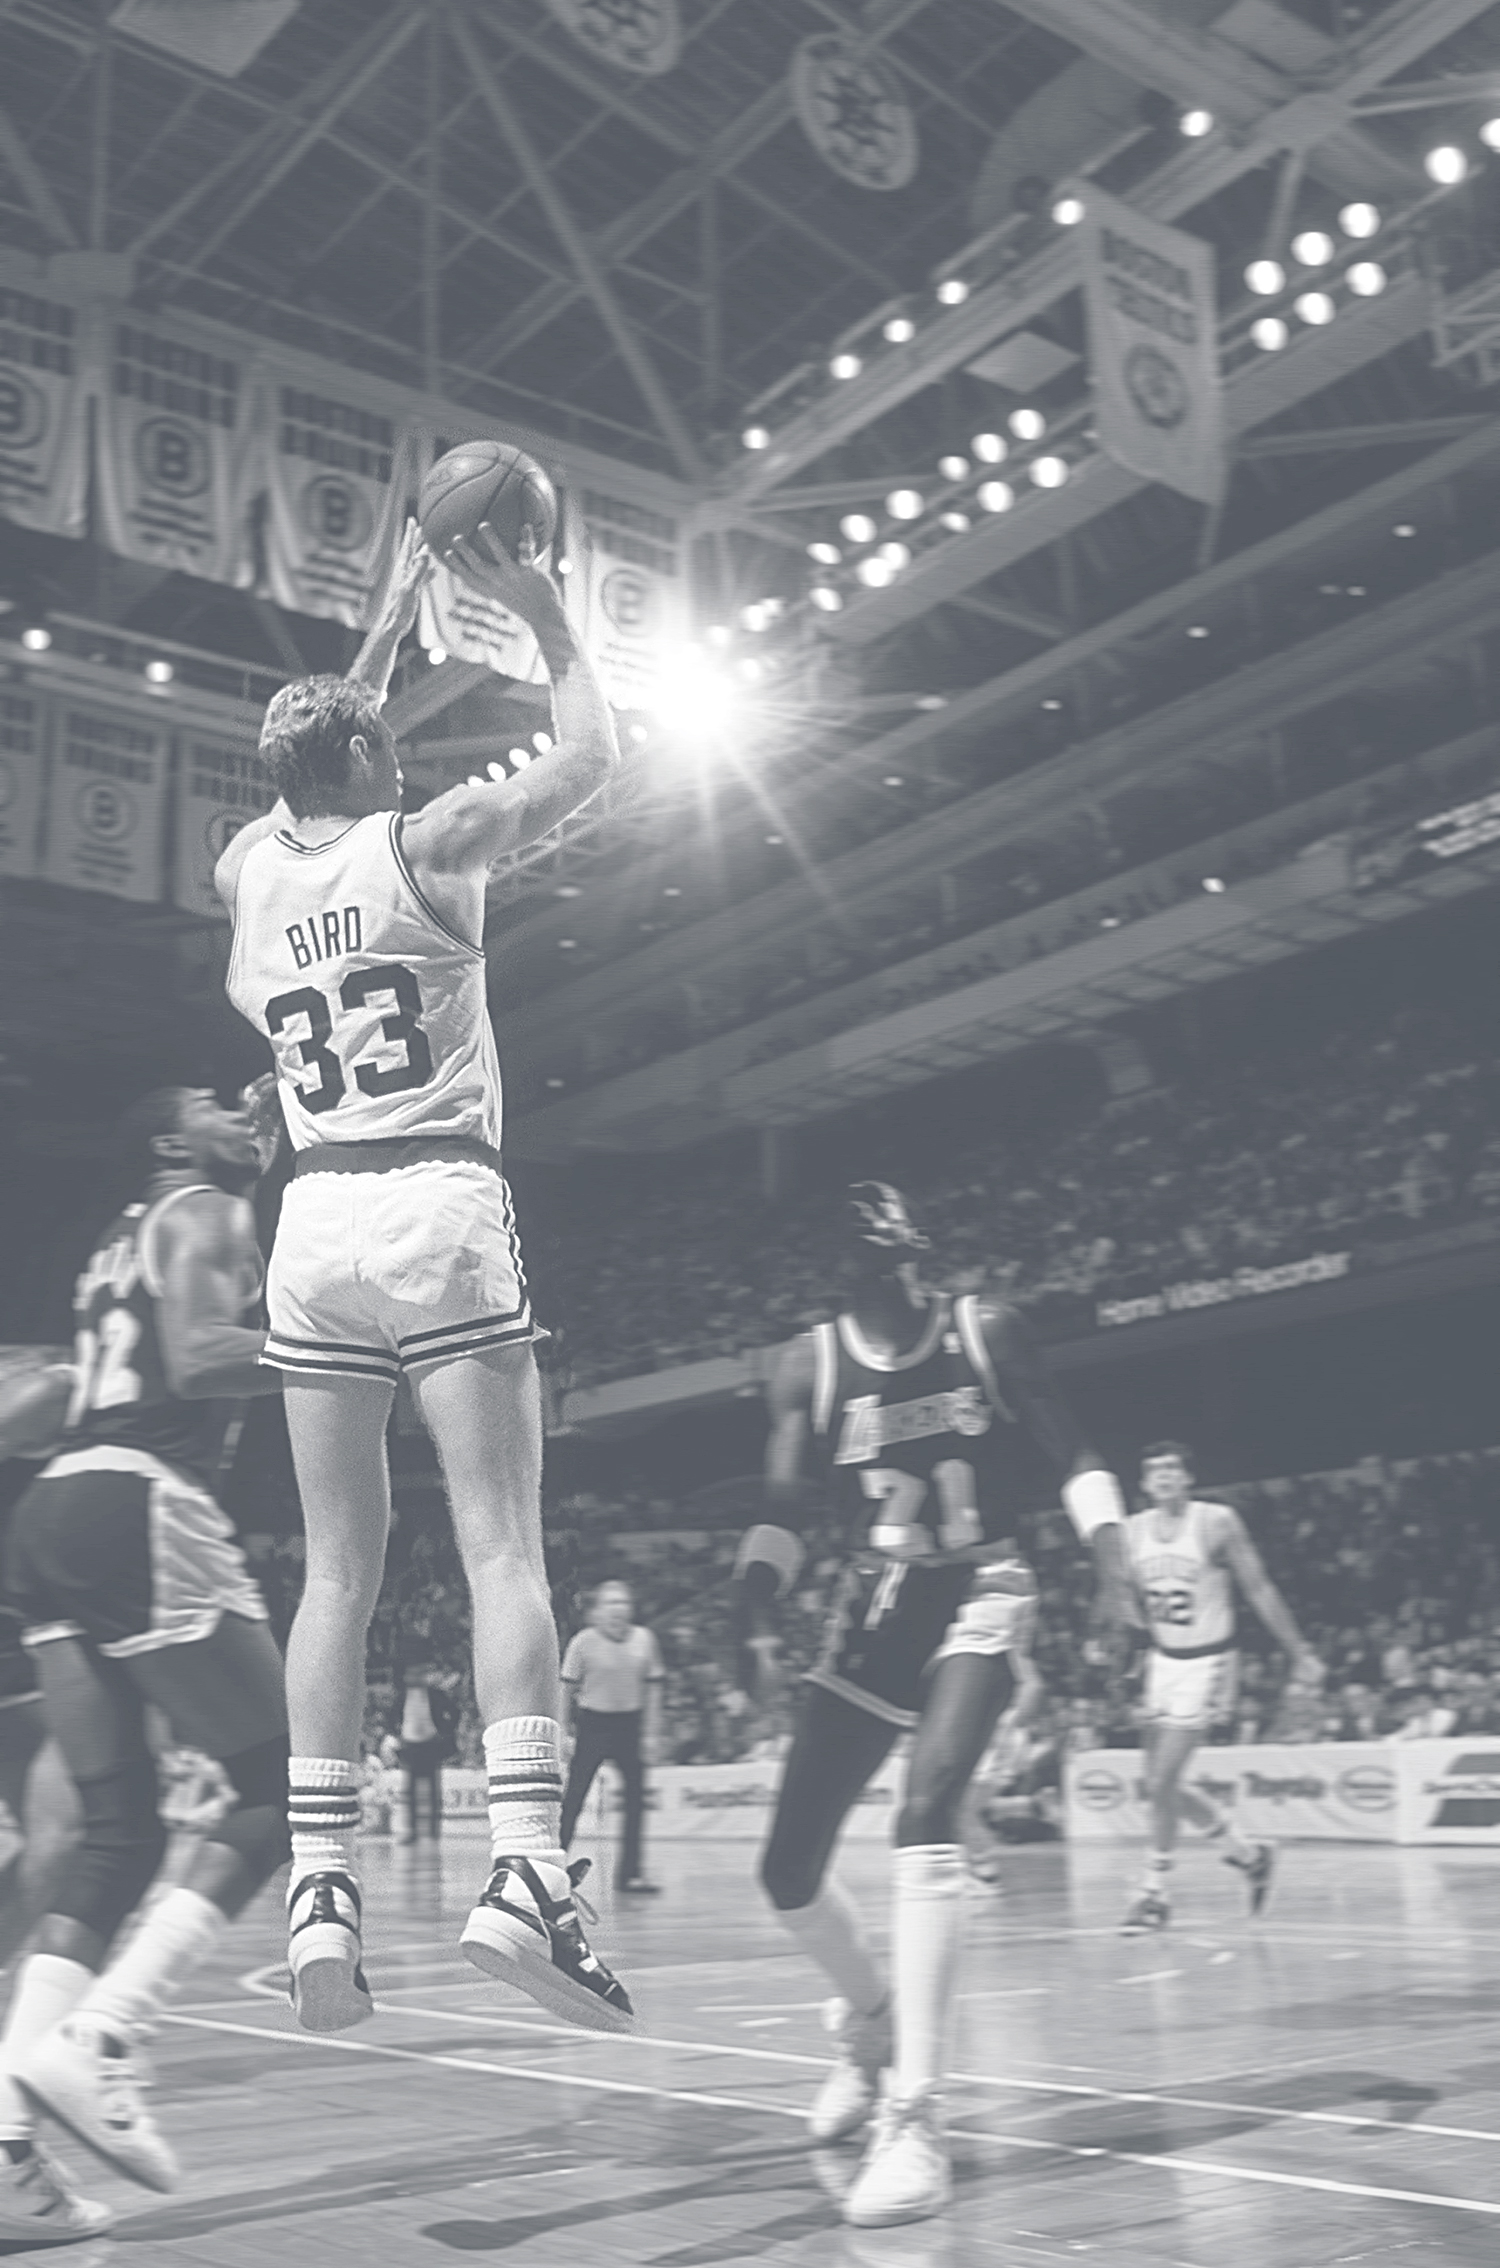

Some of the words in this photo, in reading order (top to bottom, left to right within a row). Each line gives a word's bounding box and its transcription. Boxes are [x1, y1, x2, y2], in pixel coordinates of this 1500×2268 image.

[157, 430, 189, 482] B
[322, 486, 352, 536] B
[286, 906, 362, 969] BIRD
[264, 964, 434, 1115] 33
[857, 1459, 985, 1557] 21
